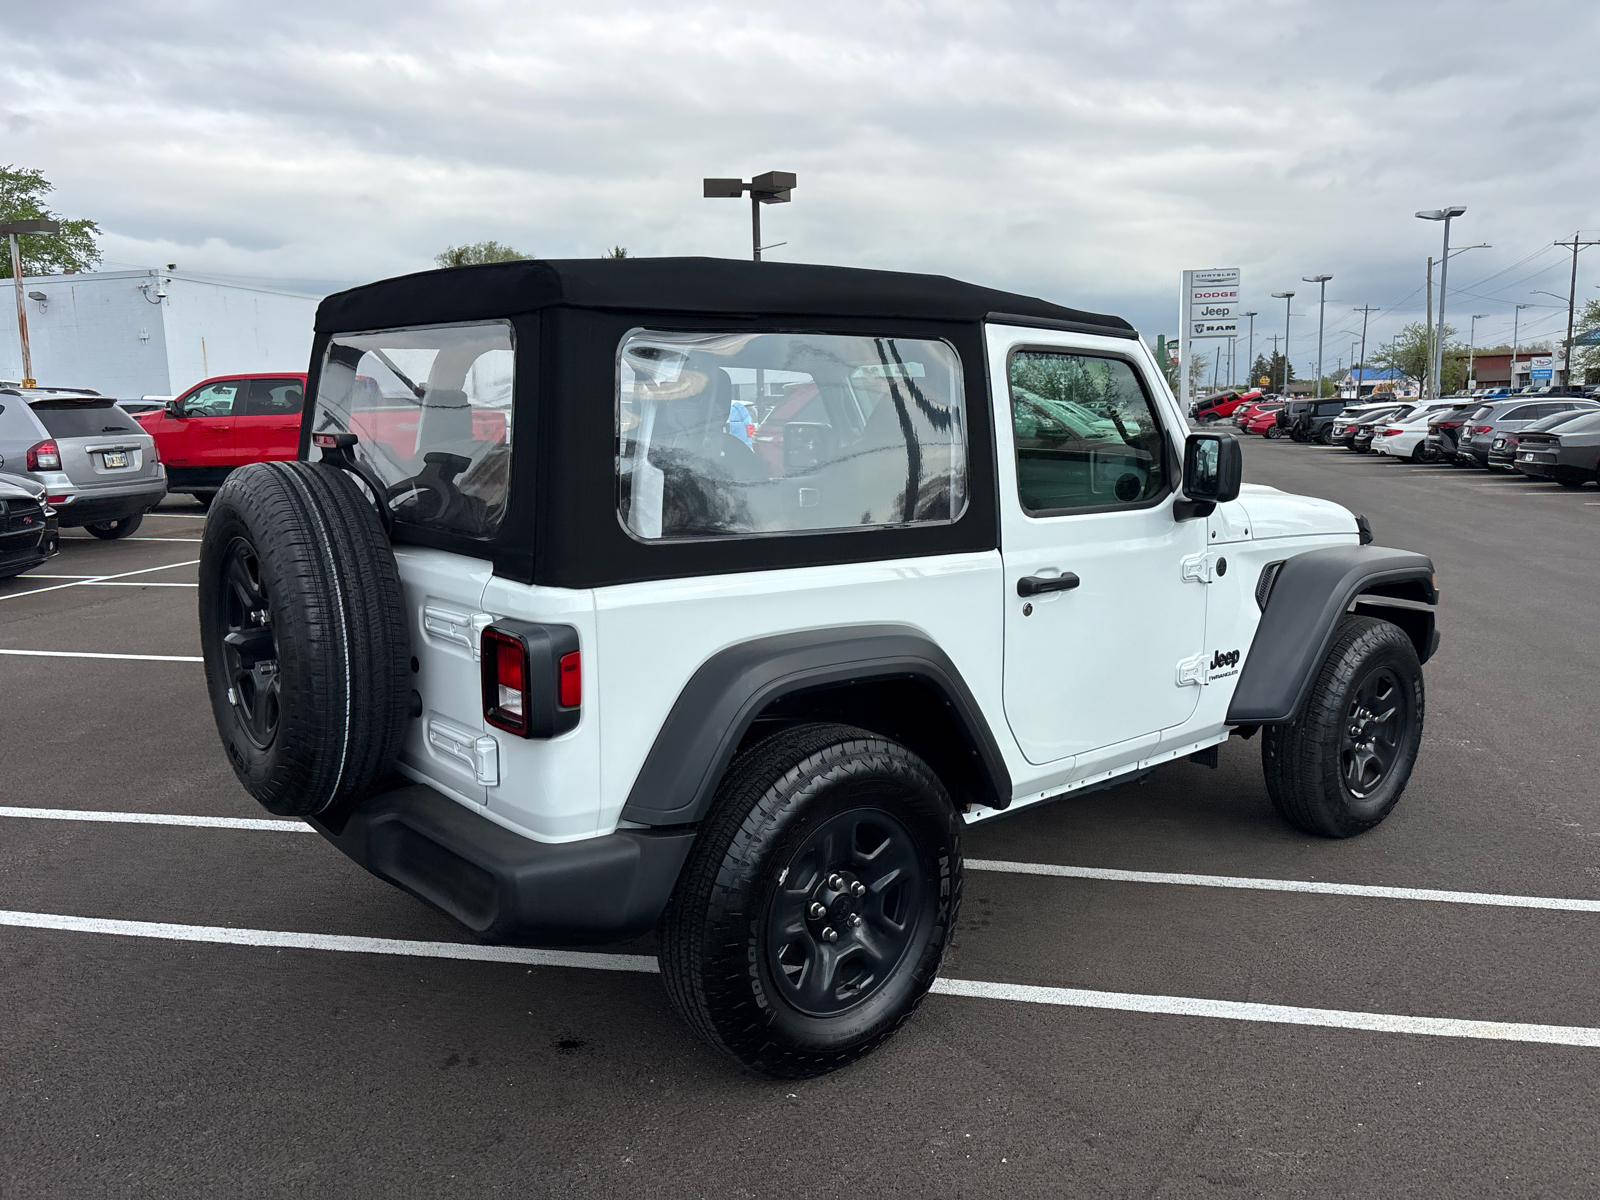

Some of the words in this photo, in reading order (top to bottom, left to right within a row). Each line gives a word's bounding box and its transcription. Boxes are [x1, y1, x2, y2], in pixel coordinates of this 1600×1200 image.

[1201, 306, 1230, 317] Jeep
[1210, 649, 1240, 670] Jeep
[1208, 670, 1239, 682] WRANGLER
[747, 917, 769, 1009] ROADIA
